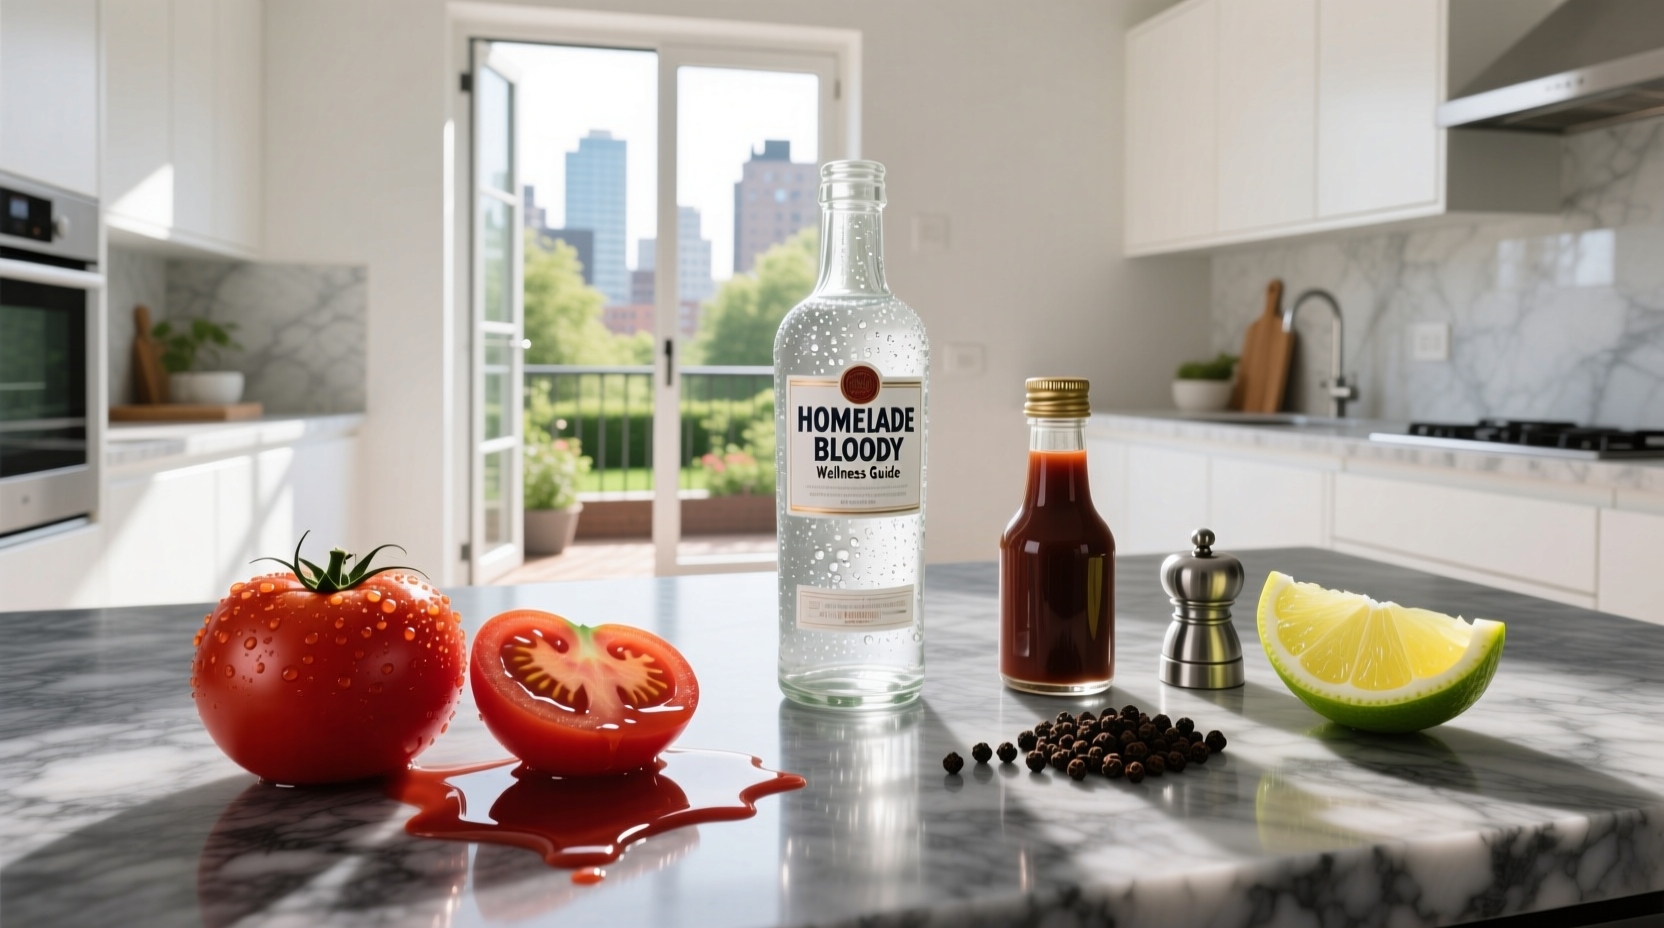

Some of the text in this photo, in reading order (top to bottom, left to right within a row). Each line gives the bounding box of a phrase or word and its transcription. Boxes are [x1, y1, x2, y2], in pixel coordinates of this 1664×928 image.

[798, 405, 915, 433] HOMELADE
[814, 436, 904, 462] BLOODY
[816, 465, 901, 479] Wellness Guide
